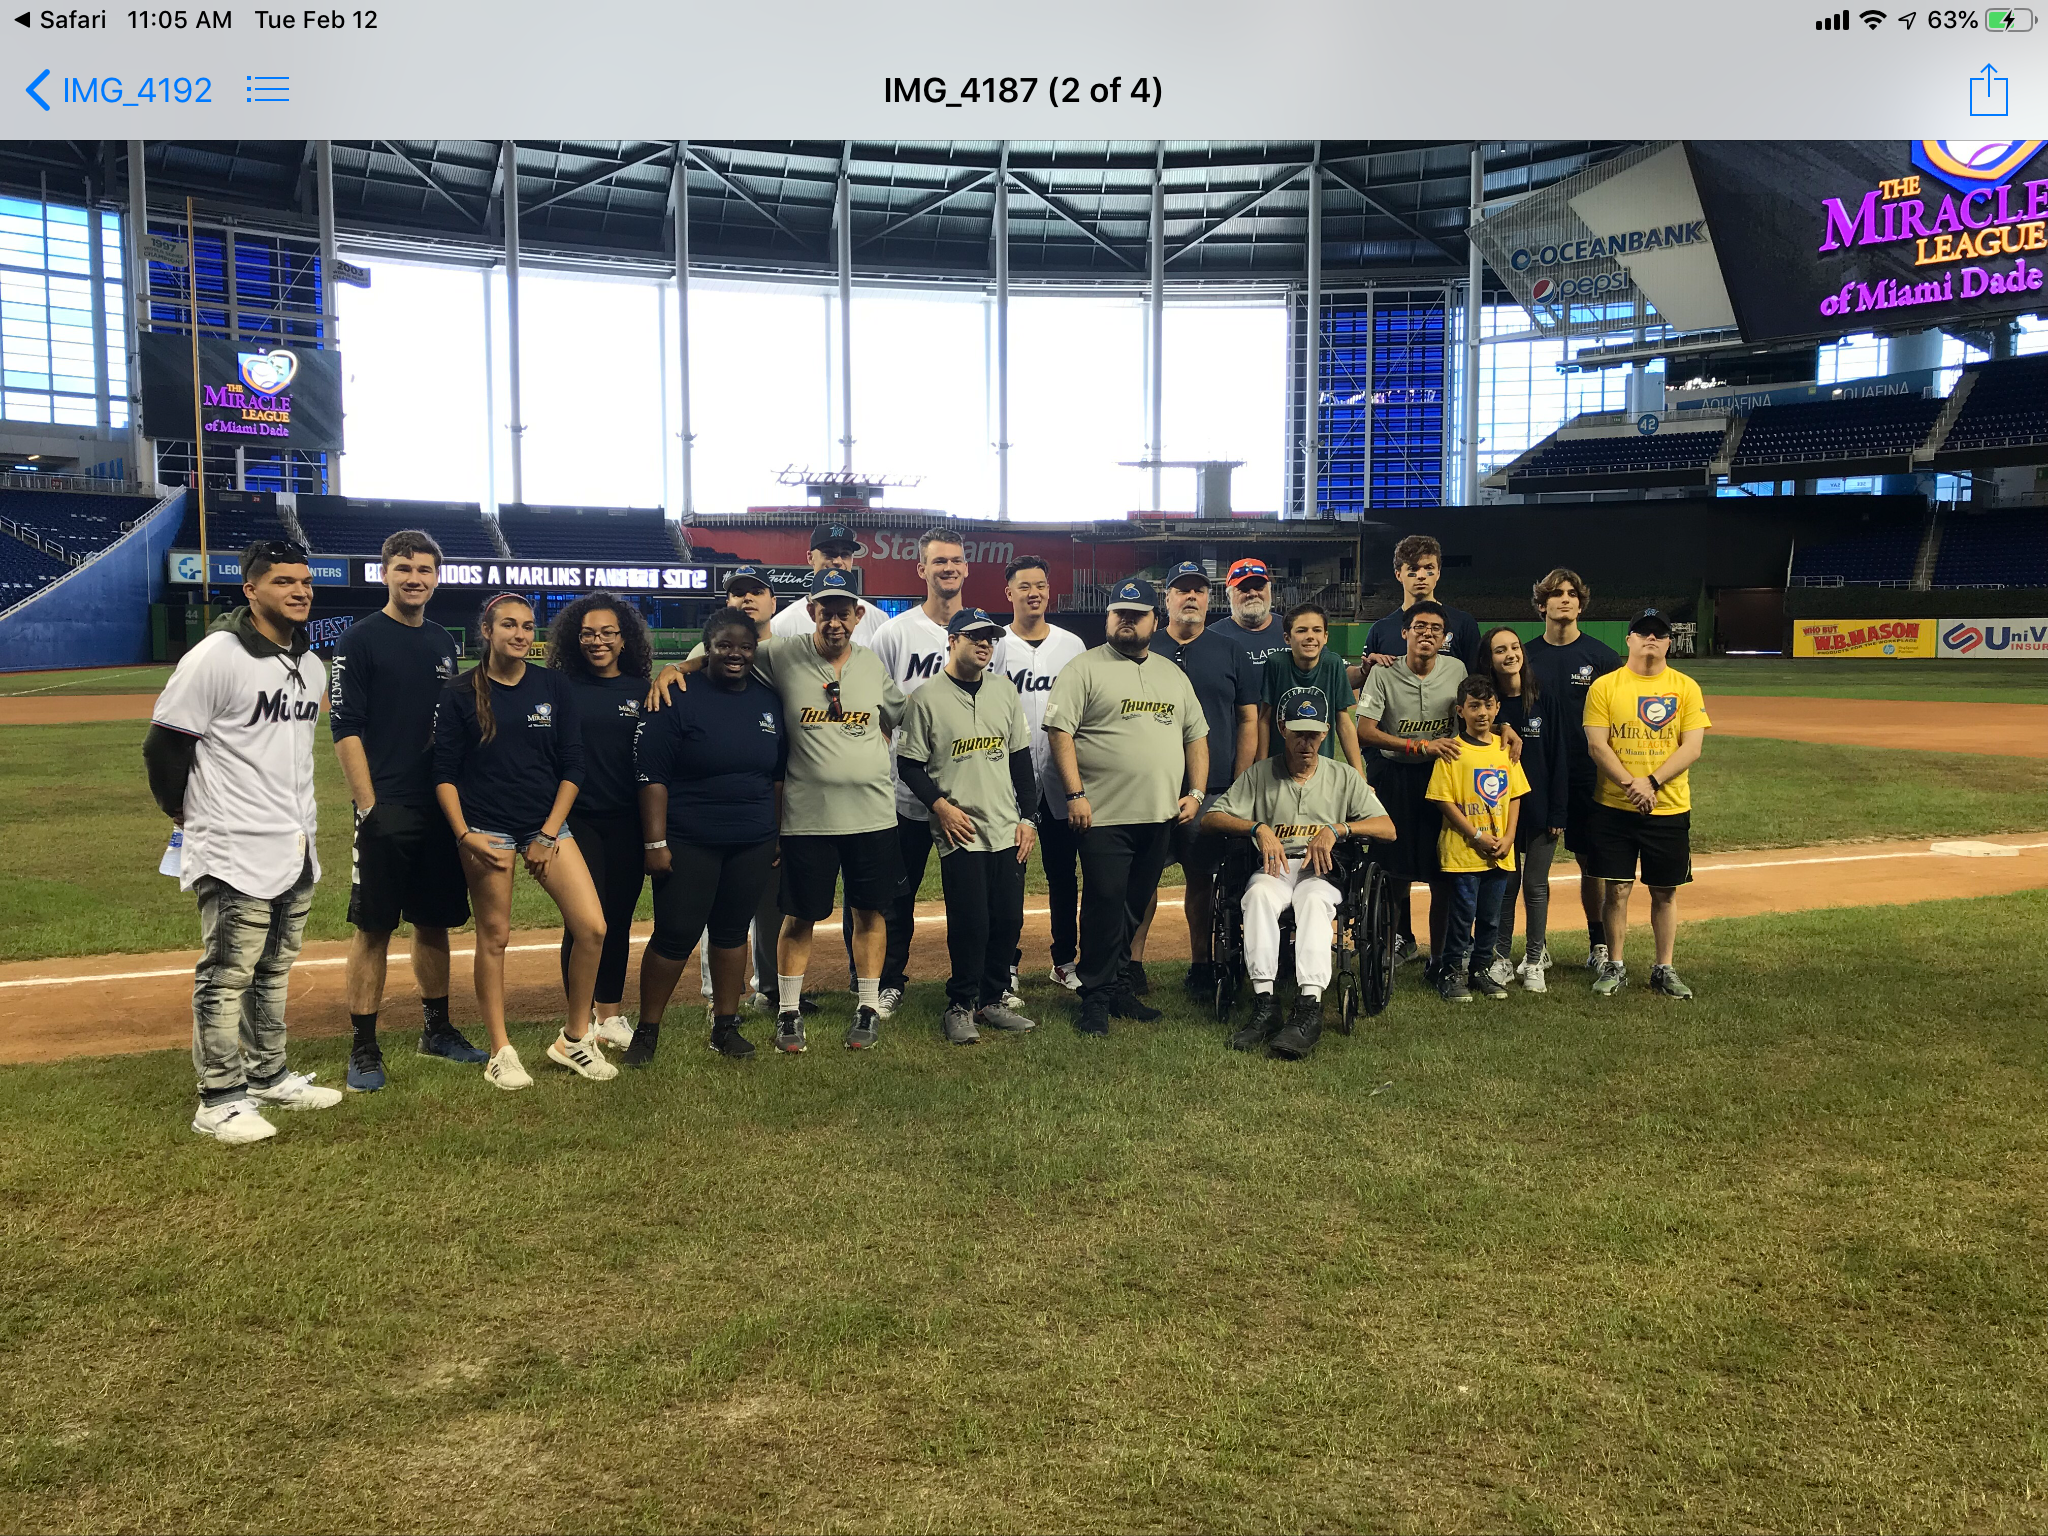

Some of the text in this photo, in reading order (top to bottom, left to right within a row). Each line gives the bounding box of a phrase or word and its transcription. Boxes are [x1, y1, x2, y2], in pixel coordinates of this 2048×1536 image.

[1879, 175, 1921, 200] THE
[1819, 178, 2048, 251] MIRACLE
[151, 238, 176, 252] 1997
[1915, 221, 2047, 265] LEAGUE
[337, 262, 363, 276] 2003
[1560, 266, 1630, 300] pepsi
[1820, 257, 2044, 316] of Miami Dade
[227, 384, 243, 392] THE
[1844, 384, 1909, 400] QUAFINA
[203, 384, 291, 412] MIRACLE
[242, 409, 290, 422] LEAGUE
[1640, 419, 1656, 430] 42
[205, 419, 289, 437] of Miami Dade
[488, 566, 500, 584] A
[506, 566, 581, 586] MARLINS
[1803, 625, 1839, 634] WHO BUT
[2011, 643, 2048, 651] INSUR
[243, 688, 318, 728] Miam
[1121, 699, 1175, 715] THUNDER
[1612, 722, 1673, 740] MIRACLE
